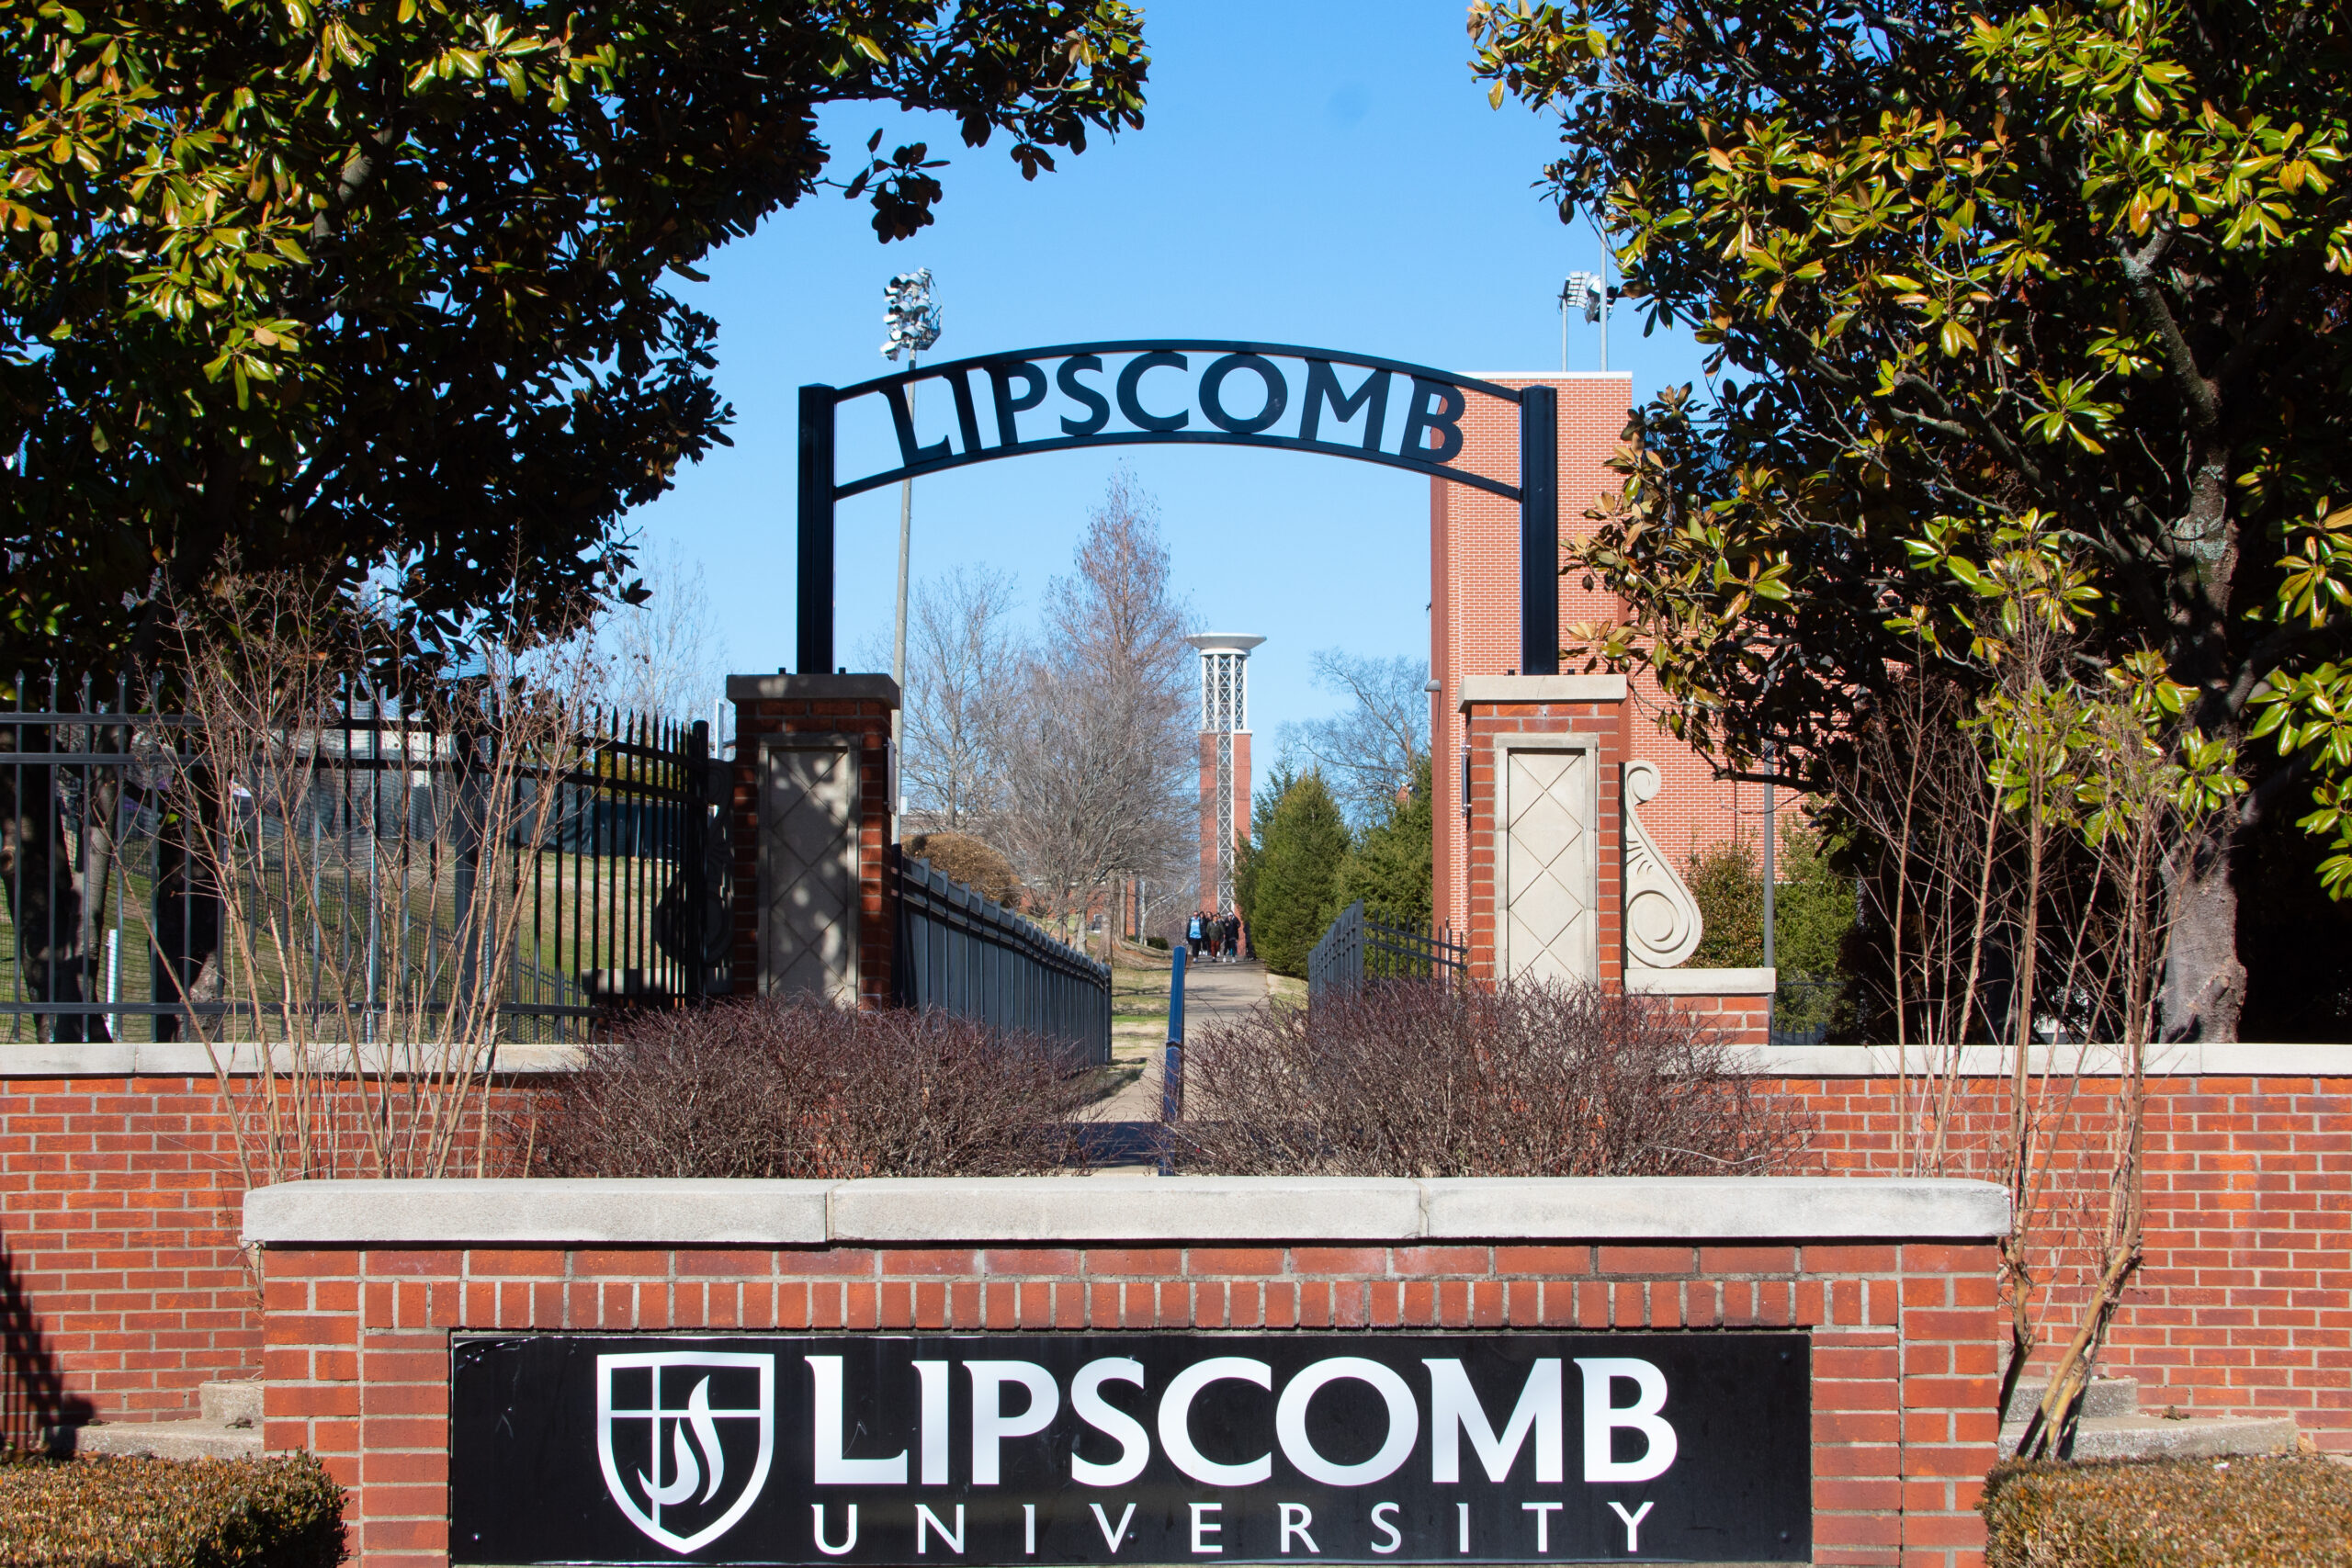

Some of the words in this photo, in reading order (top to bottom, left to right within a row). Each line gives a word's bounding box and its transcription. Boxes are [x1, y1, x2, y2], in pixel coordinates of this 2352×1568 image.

[879, 351, 1465, 467] LIPSCOMB
[804, 1355, 1678, 1487] LIPSCOMB
[810, 1501, 1656, 1555] UNIVERSITY
